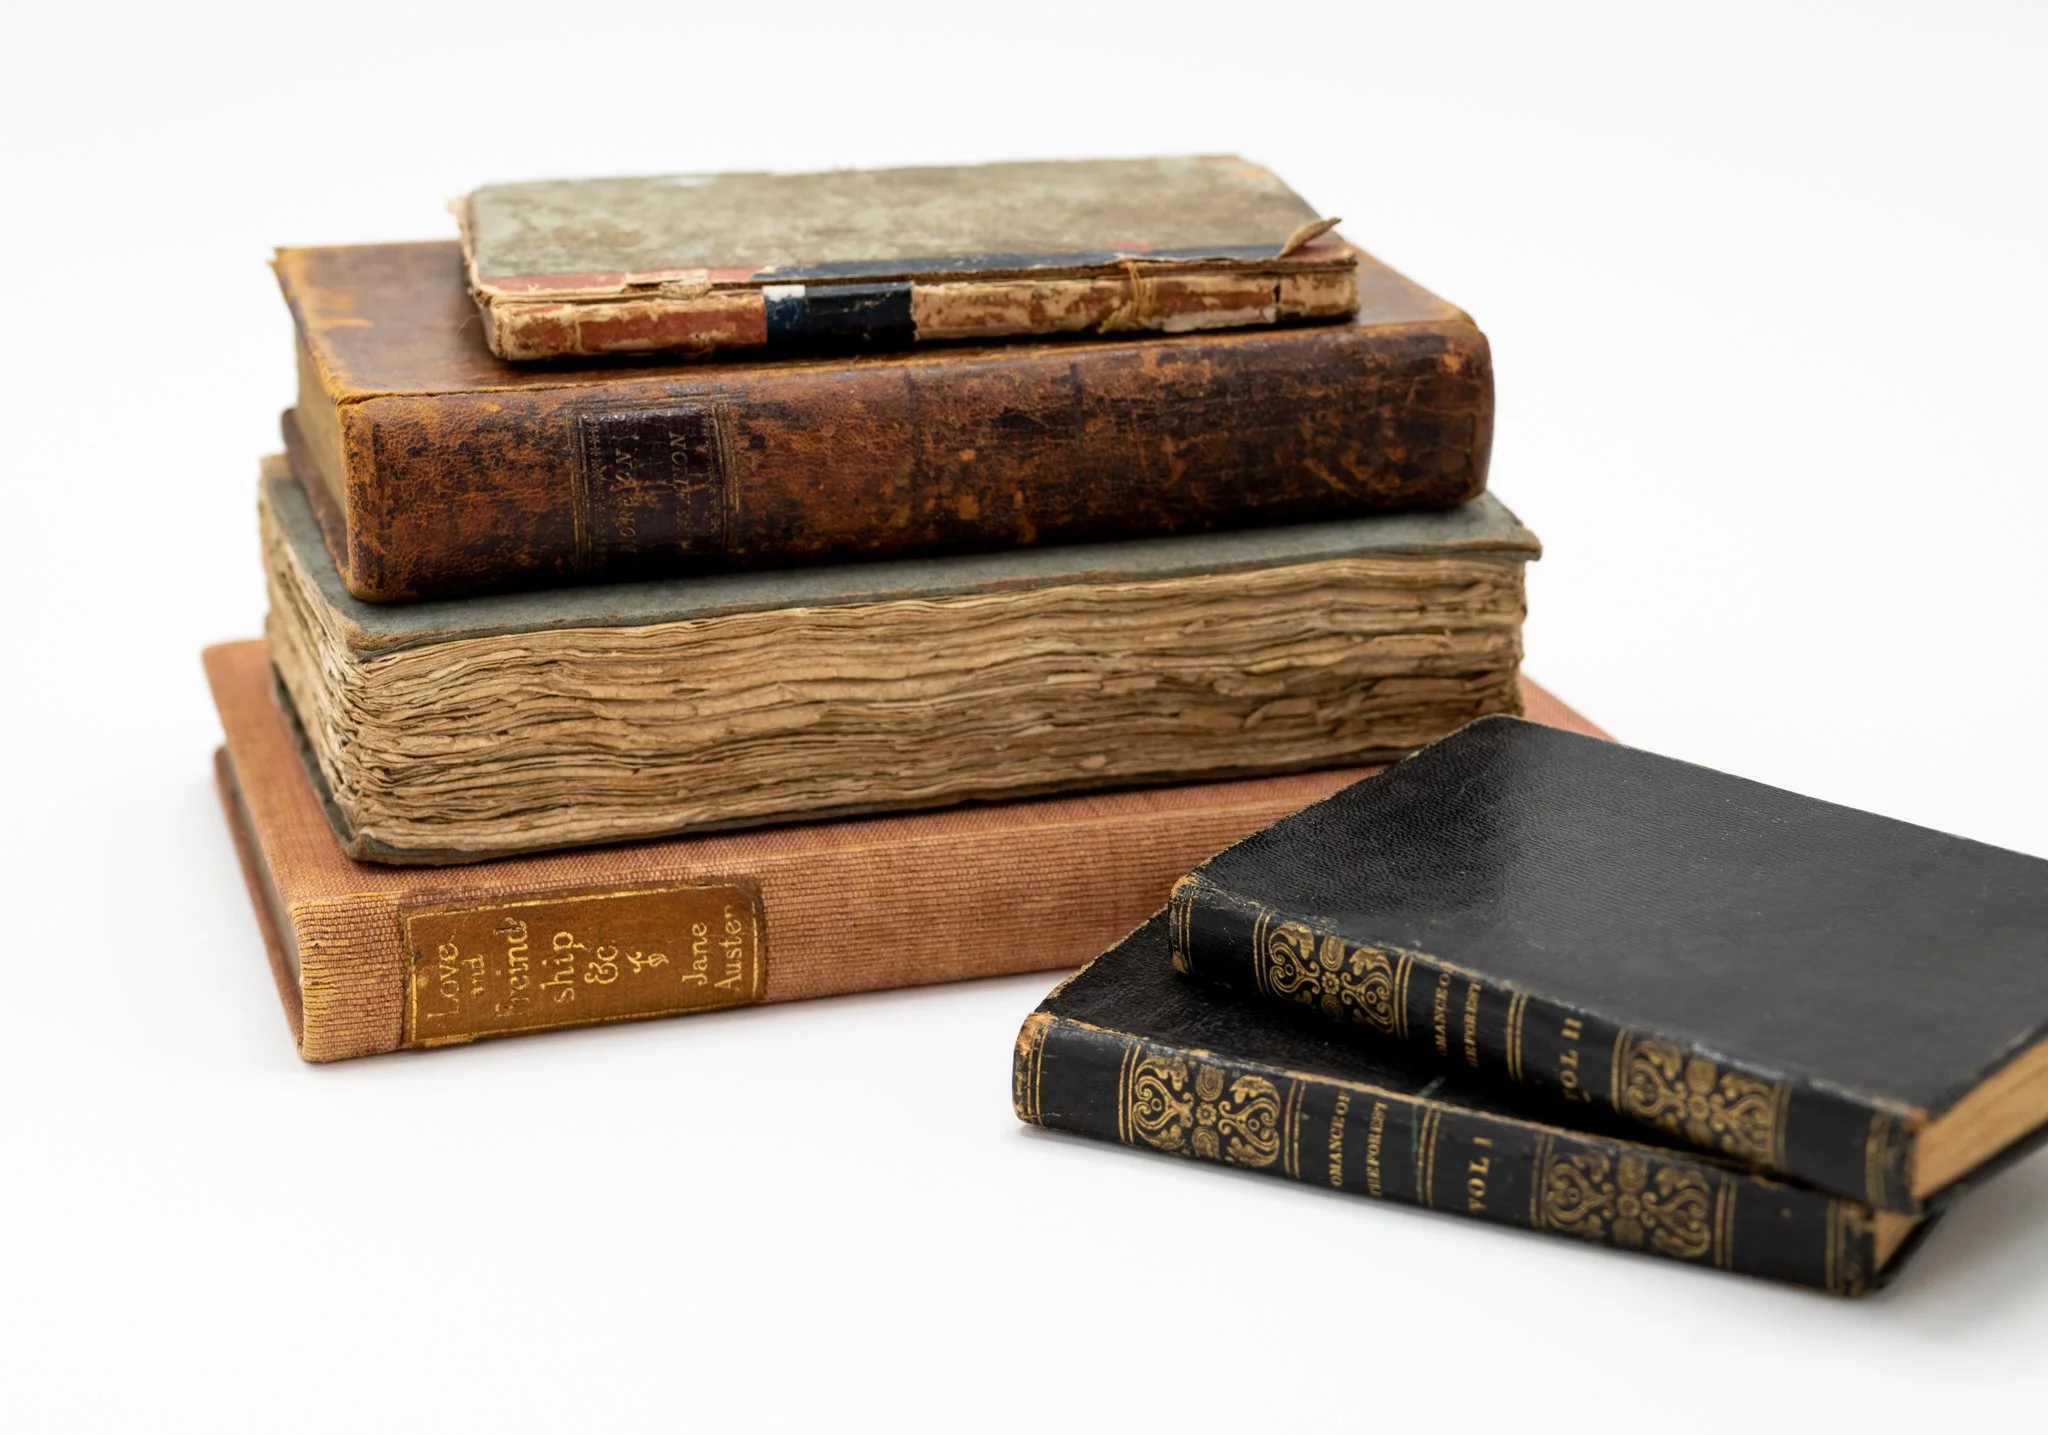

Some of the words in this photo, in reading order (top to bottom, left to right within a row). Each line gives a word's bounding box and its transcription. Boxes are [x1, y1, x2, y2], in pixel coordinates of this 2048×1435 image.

[462, 952, 487, 996] and
[541, 930, 588, 1003] ship
[681, 922, 708, 986] Jane
[714, 904, 743, 992] Austen
[426, 942, 460, 1019] Love
[1561, 1017, 1583, 1041] II
[1334, 1090, 1350, 1116] OF
[1365, 1102, 1388, 1167] FOREST
[1471, 1136, 1493, 1149] I
[1366, 1167, 1383, 1198] THE
[1467, 1156, 1491, 1212] VOL
